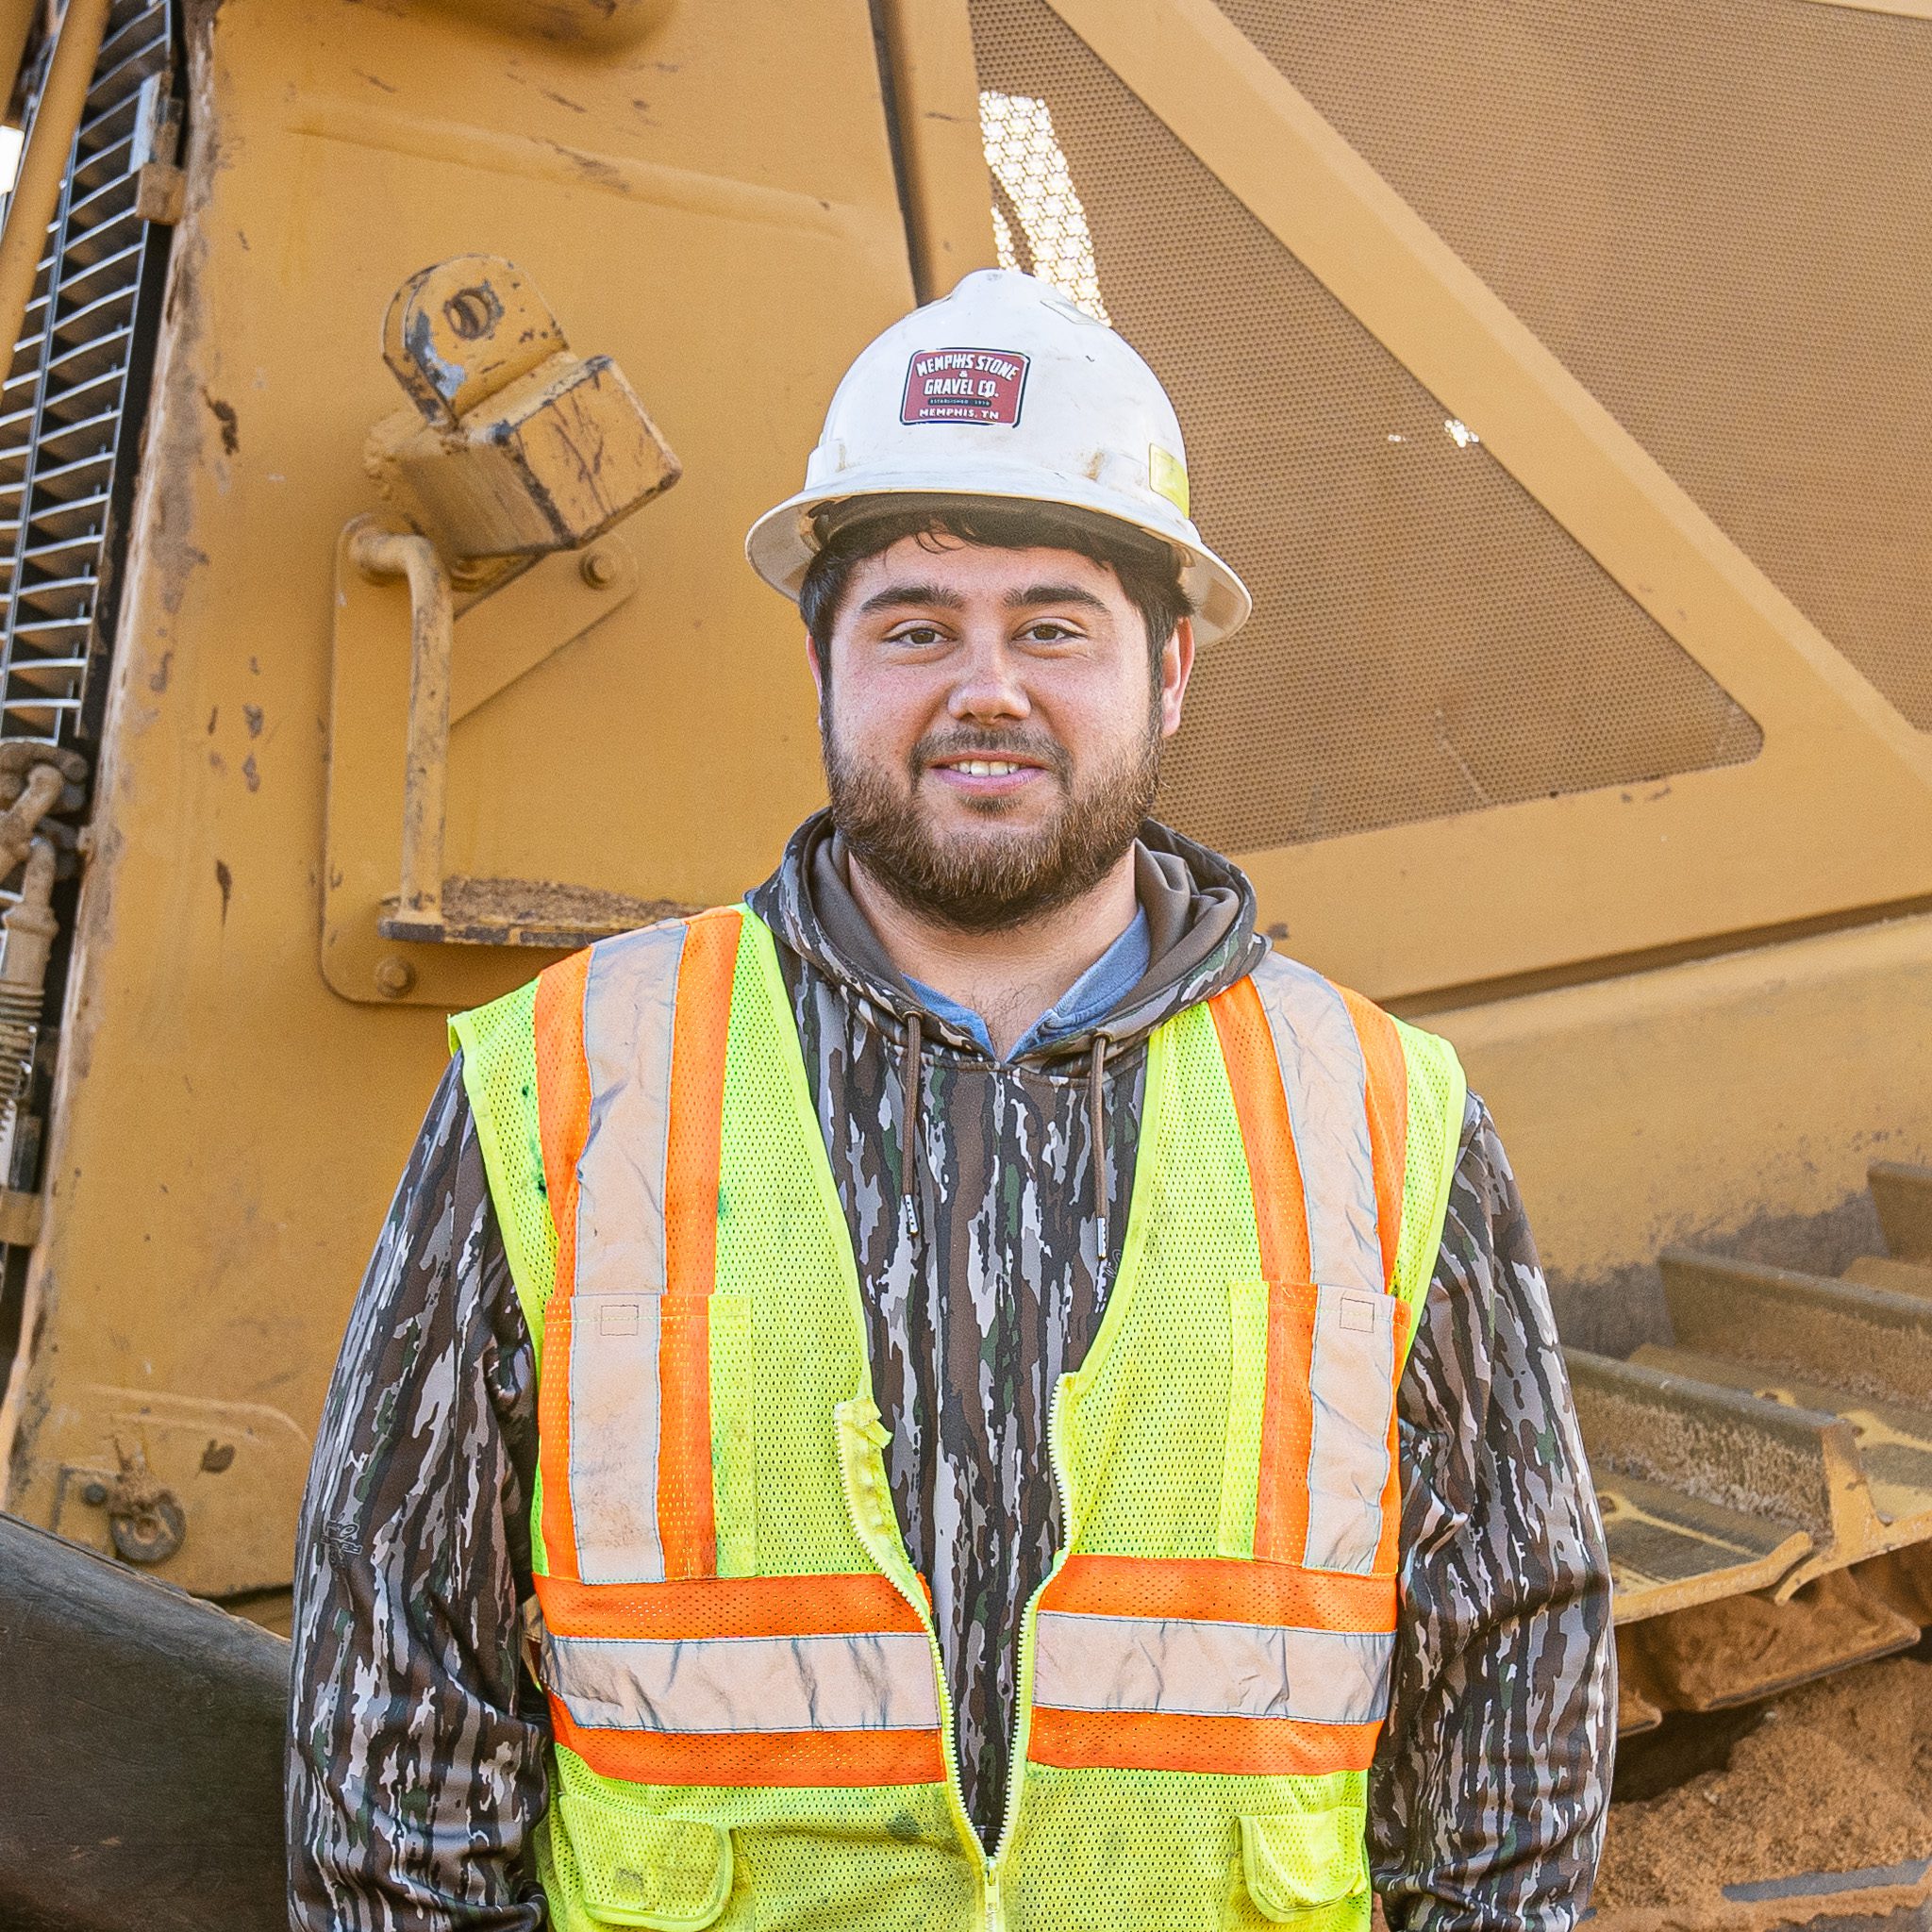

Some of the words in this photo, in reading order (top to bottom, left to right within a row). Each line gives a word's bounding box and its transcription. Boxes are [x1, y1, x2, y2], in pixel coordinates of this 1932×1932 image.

[916, 353, 975, 377] MEMPHIS
[975, 355, 1020, 381] STONE
[924, 378, 974, 395] GRAVEL
[977, 379, 999, 397] CO.
[981, 409, 999, 420] TN
